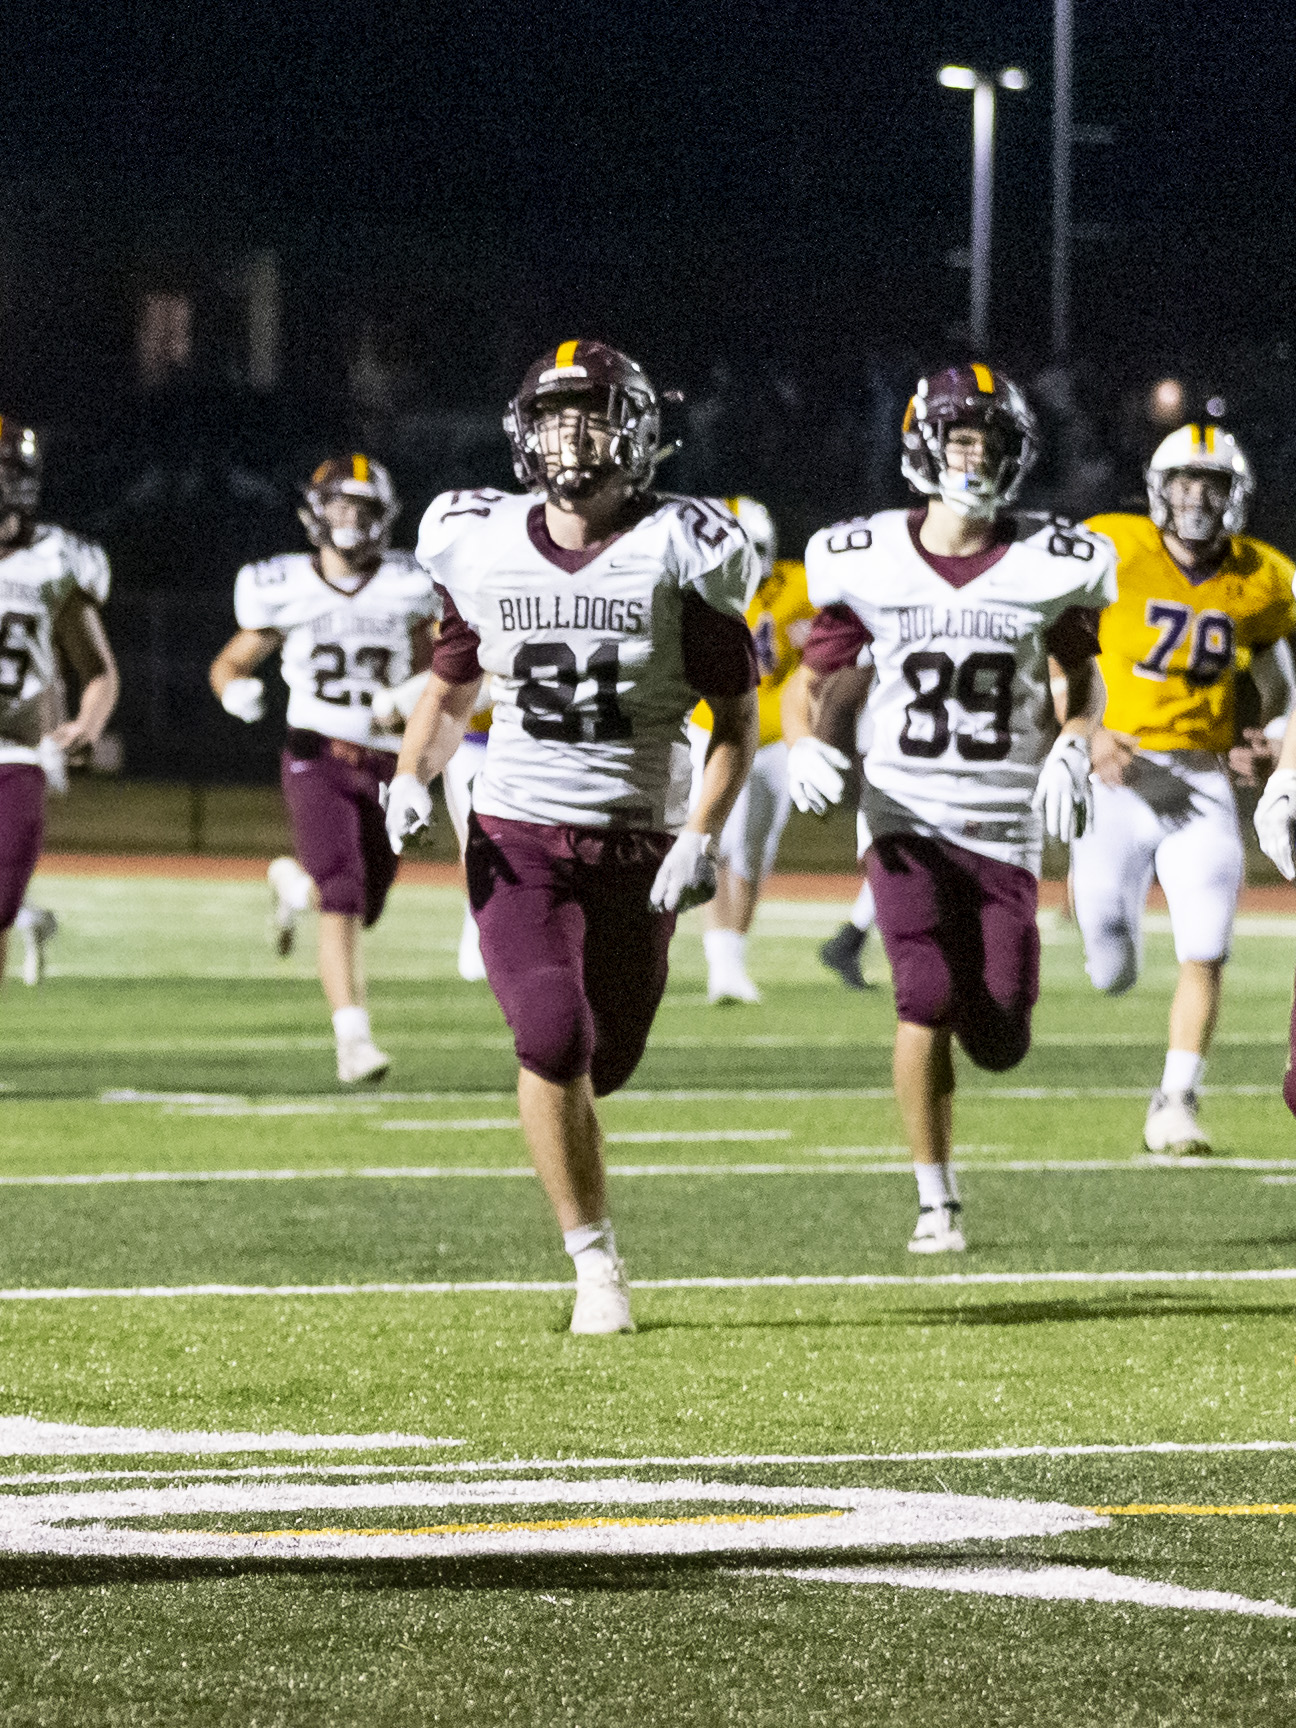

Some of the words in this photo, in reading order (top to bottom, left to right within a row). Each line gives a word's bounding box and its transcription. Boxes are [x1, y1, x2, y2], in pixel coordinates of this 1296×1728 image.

[498, 595, 643, 636] BULLDOGS
[897, 607, 1020, 642] BULLDOGS
[310, 641, 392, 707] 23
[898, 651, 1017, 762] 89
